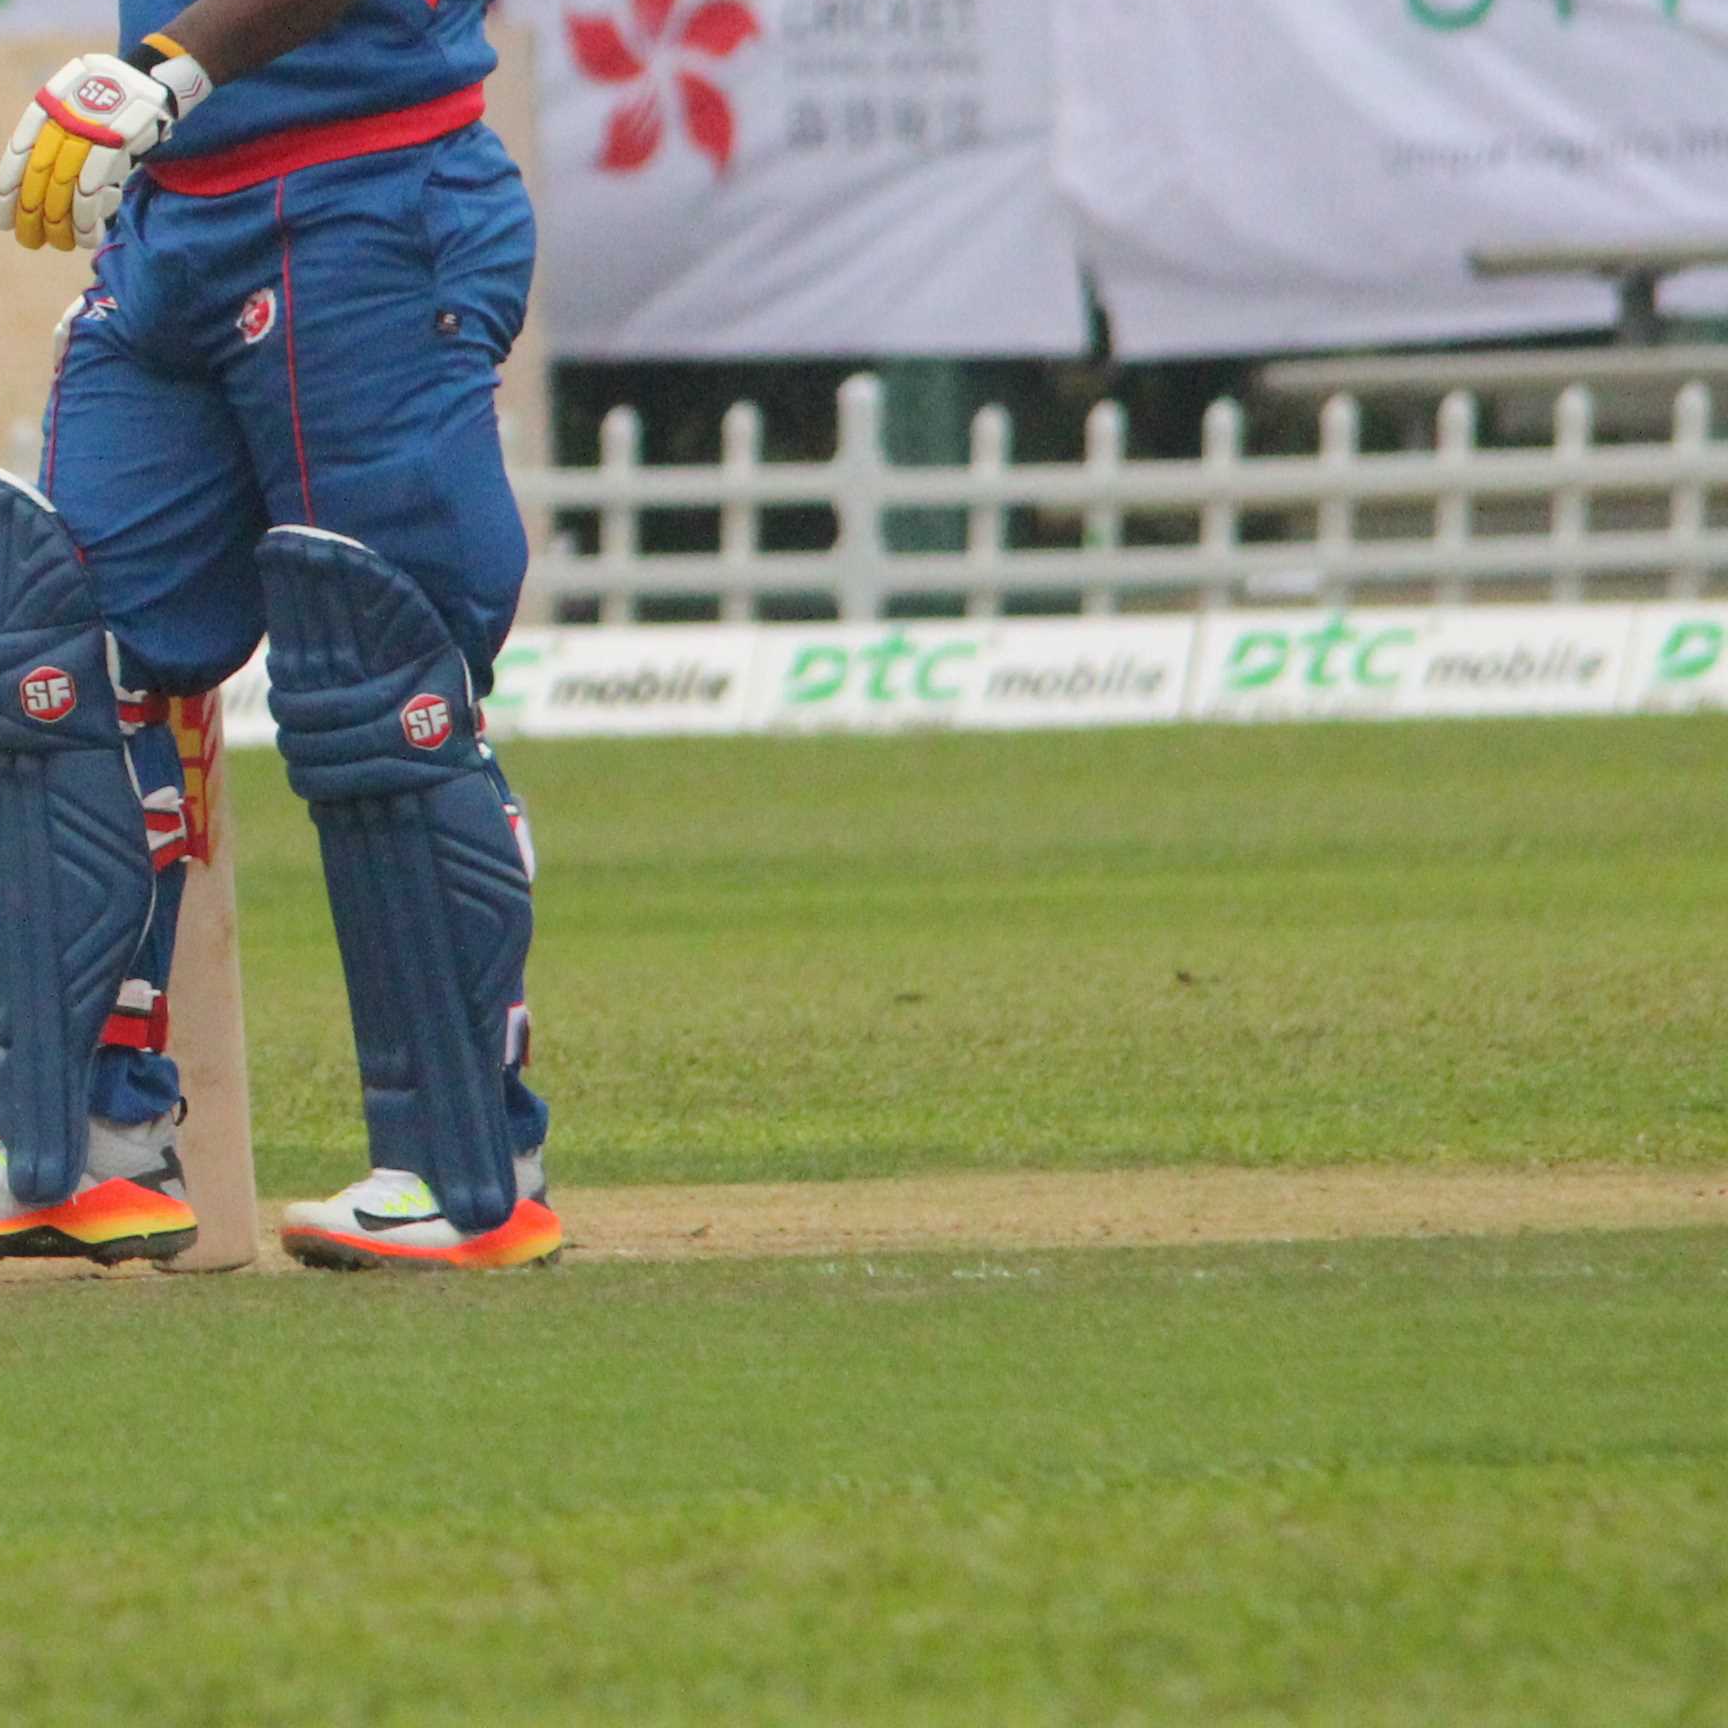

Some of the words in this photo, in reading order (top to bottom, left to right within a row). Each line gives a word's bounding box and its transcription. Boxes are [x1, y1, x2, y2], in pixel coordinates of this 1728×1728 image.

[549, 660, 731, 708] mobile
[984, 652, 1165, 700] mobile
[1422, 638, 1607, 690] mobile
[26, 676, 74, 712] SF
[408, 702, 449, 741] SF
